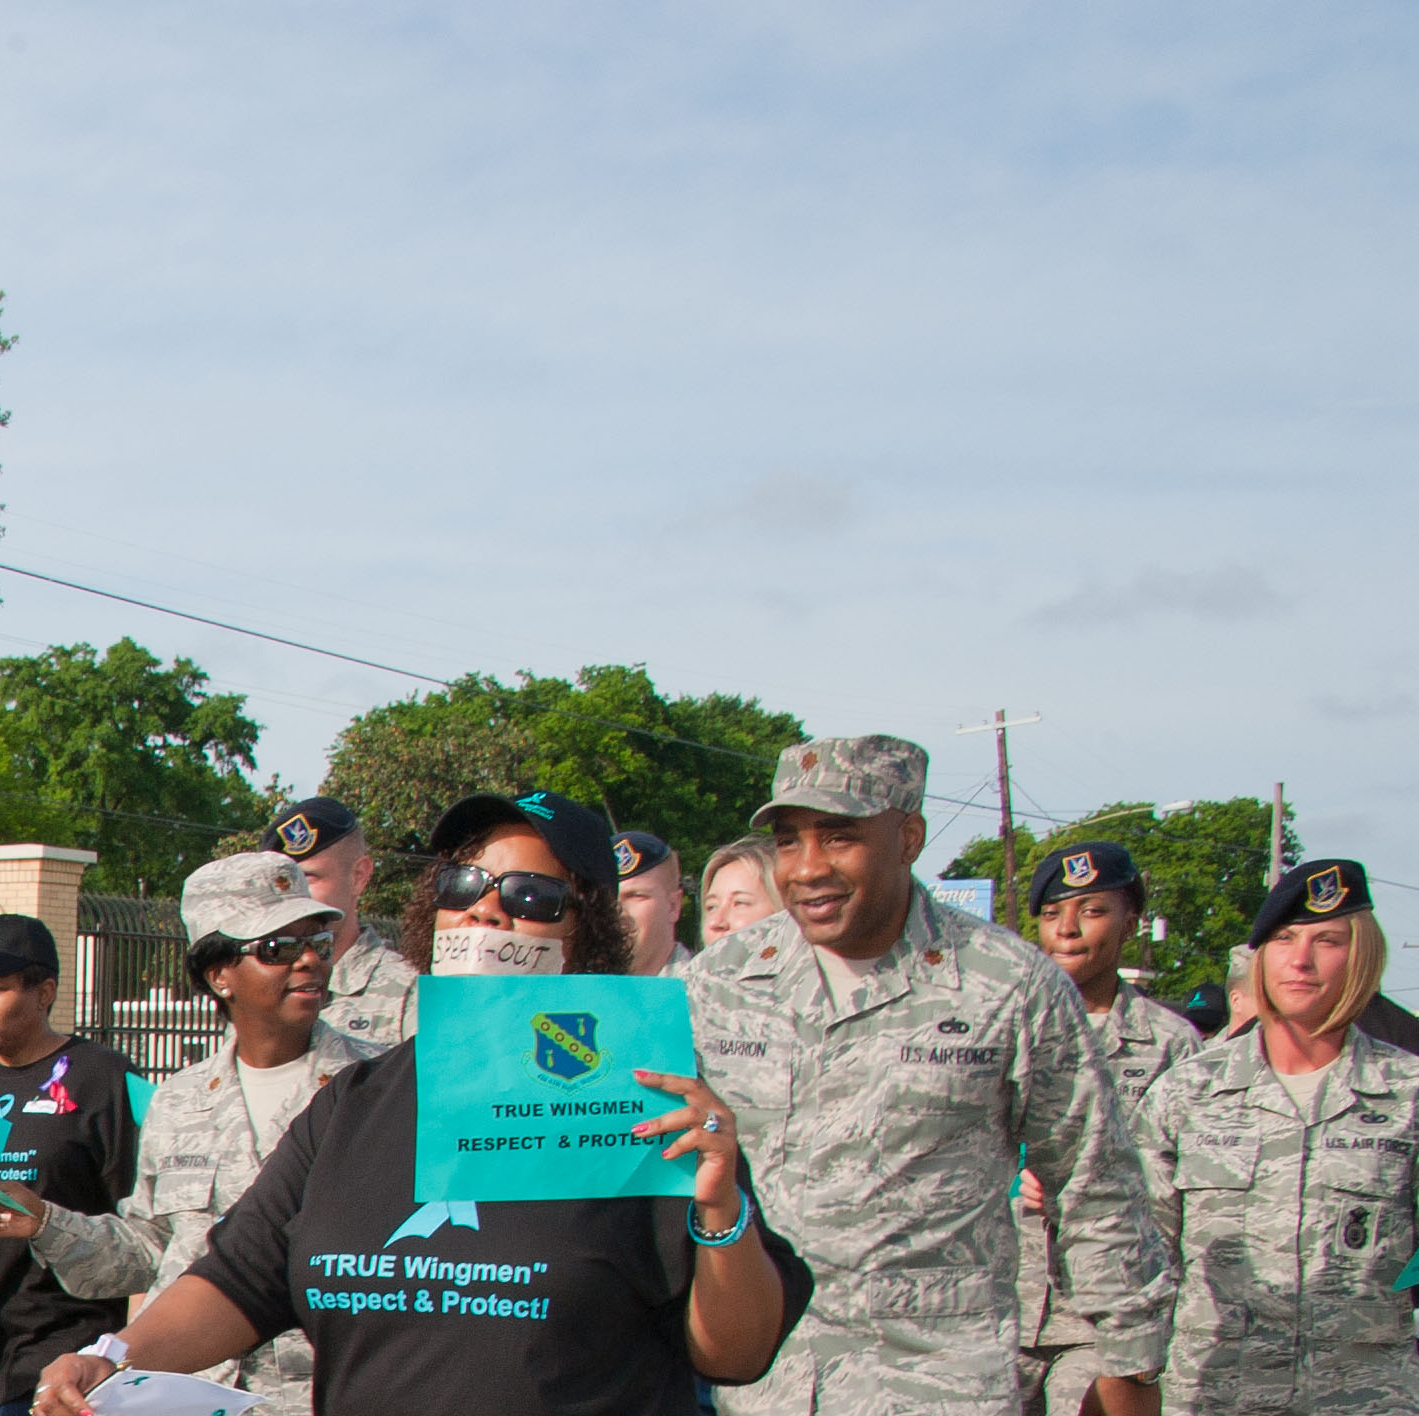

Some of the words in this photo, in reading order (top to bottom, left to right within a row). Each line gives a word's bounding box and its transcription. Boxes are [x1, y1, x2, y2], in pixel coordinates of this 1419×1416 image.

[719, 1038, 768, 1058] BARRON
[900, 1045, 923, 1063] U.S.
[929, 1046, 954, 1064] AIR
[957, 1047, 998, 1065] FORCE
[491, 1103, 544, 1119] TRUE
[549, 1100, 644, 1117] WINGMEN
[457, 1135, 546, 1152] RESPECT
[558, 1134, 571, 1149] &
[578, 1132, 668, 1148] PROTECT
[1195, 1135, 1243, 1148] OGILVIE
[1325, 1137, 1349, 1149] U.S.
[1352, 1137, 1374, 1149] AIR
[403, 1255, 549, 1287] Wingmen"
[305, 1287, 408, 1315] Respect
[413, 1288, 434, 1313] &
[440, 1289, 550, 1320] Protect!
